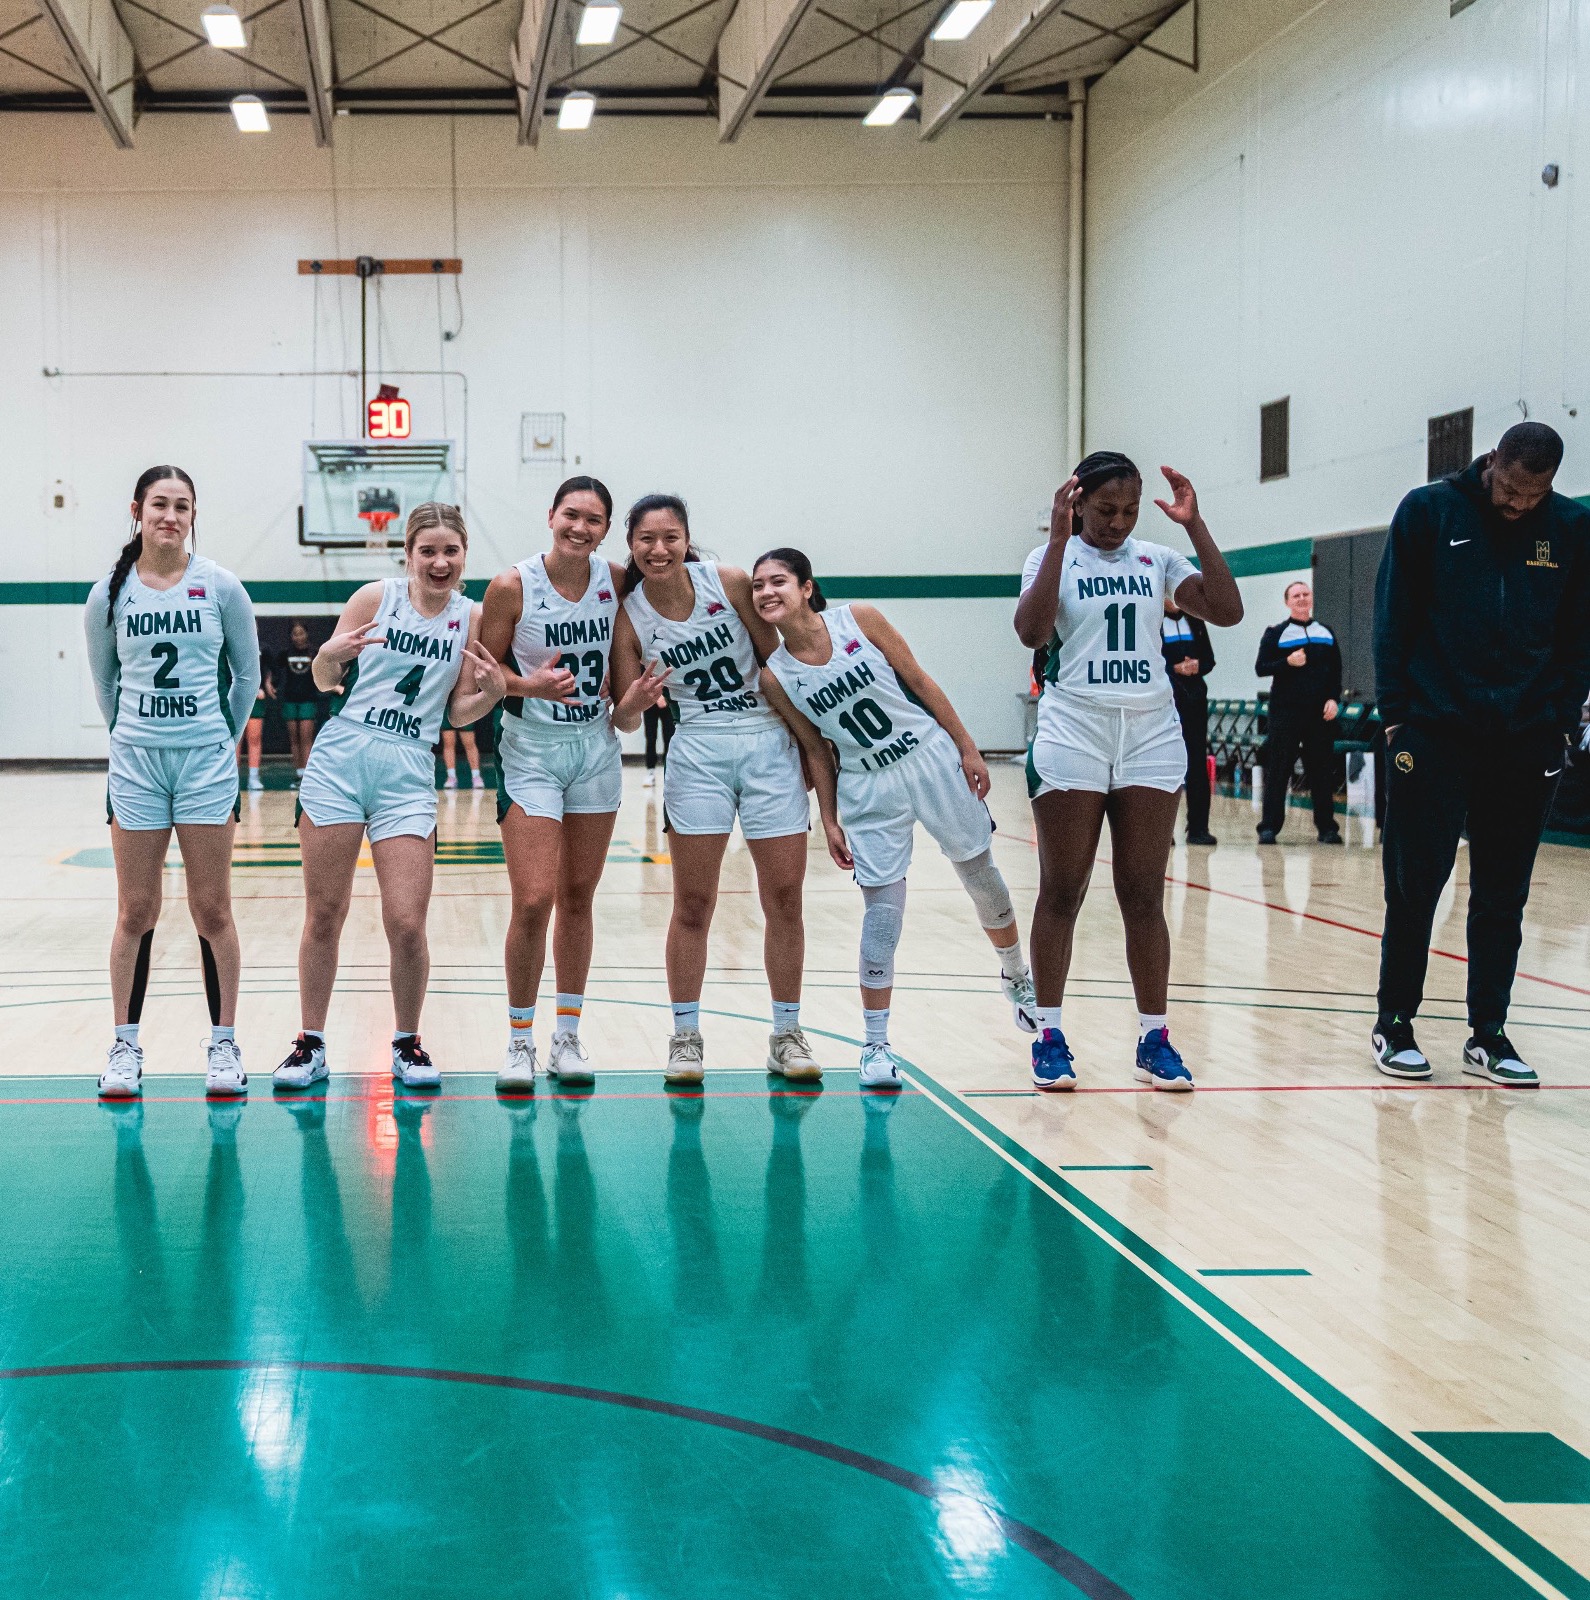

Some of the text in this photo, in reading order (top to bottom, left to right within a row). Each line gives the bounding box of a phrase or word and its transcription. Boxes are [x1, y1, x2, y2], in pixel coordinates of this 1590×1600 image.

[370, 401, 408, 437] 30
[1526, 560, 1559, 568] BASKETBALL
[1077, 575, 1153, 600] NOMAH
[126, 610, 202, 638] NOMAH
[545, 616, 610, 647] NOMAH
[1104, 602, 1136, 651] 11
[383, 628, 453, 663] NOMAH
[660, 622, 734, 669] NOMAH
[151, 642, 180, 689] 2
[553, 650, 604, 698] 23
[683, 656, 745, 701] 20
[1087, 659, 1150, 684] LIONS
[394, 664, 426, 706] 4
[806, 661, 876, 717] NOMAH
[138, 694, 198, 718] LIONS
[363, 706, 422, 739] LIONS
[552, 700, 601, 722] LION
[838, 697, 893, 749] 10
